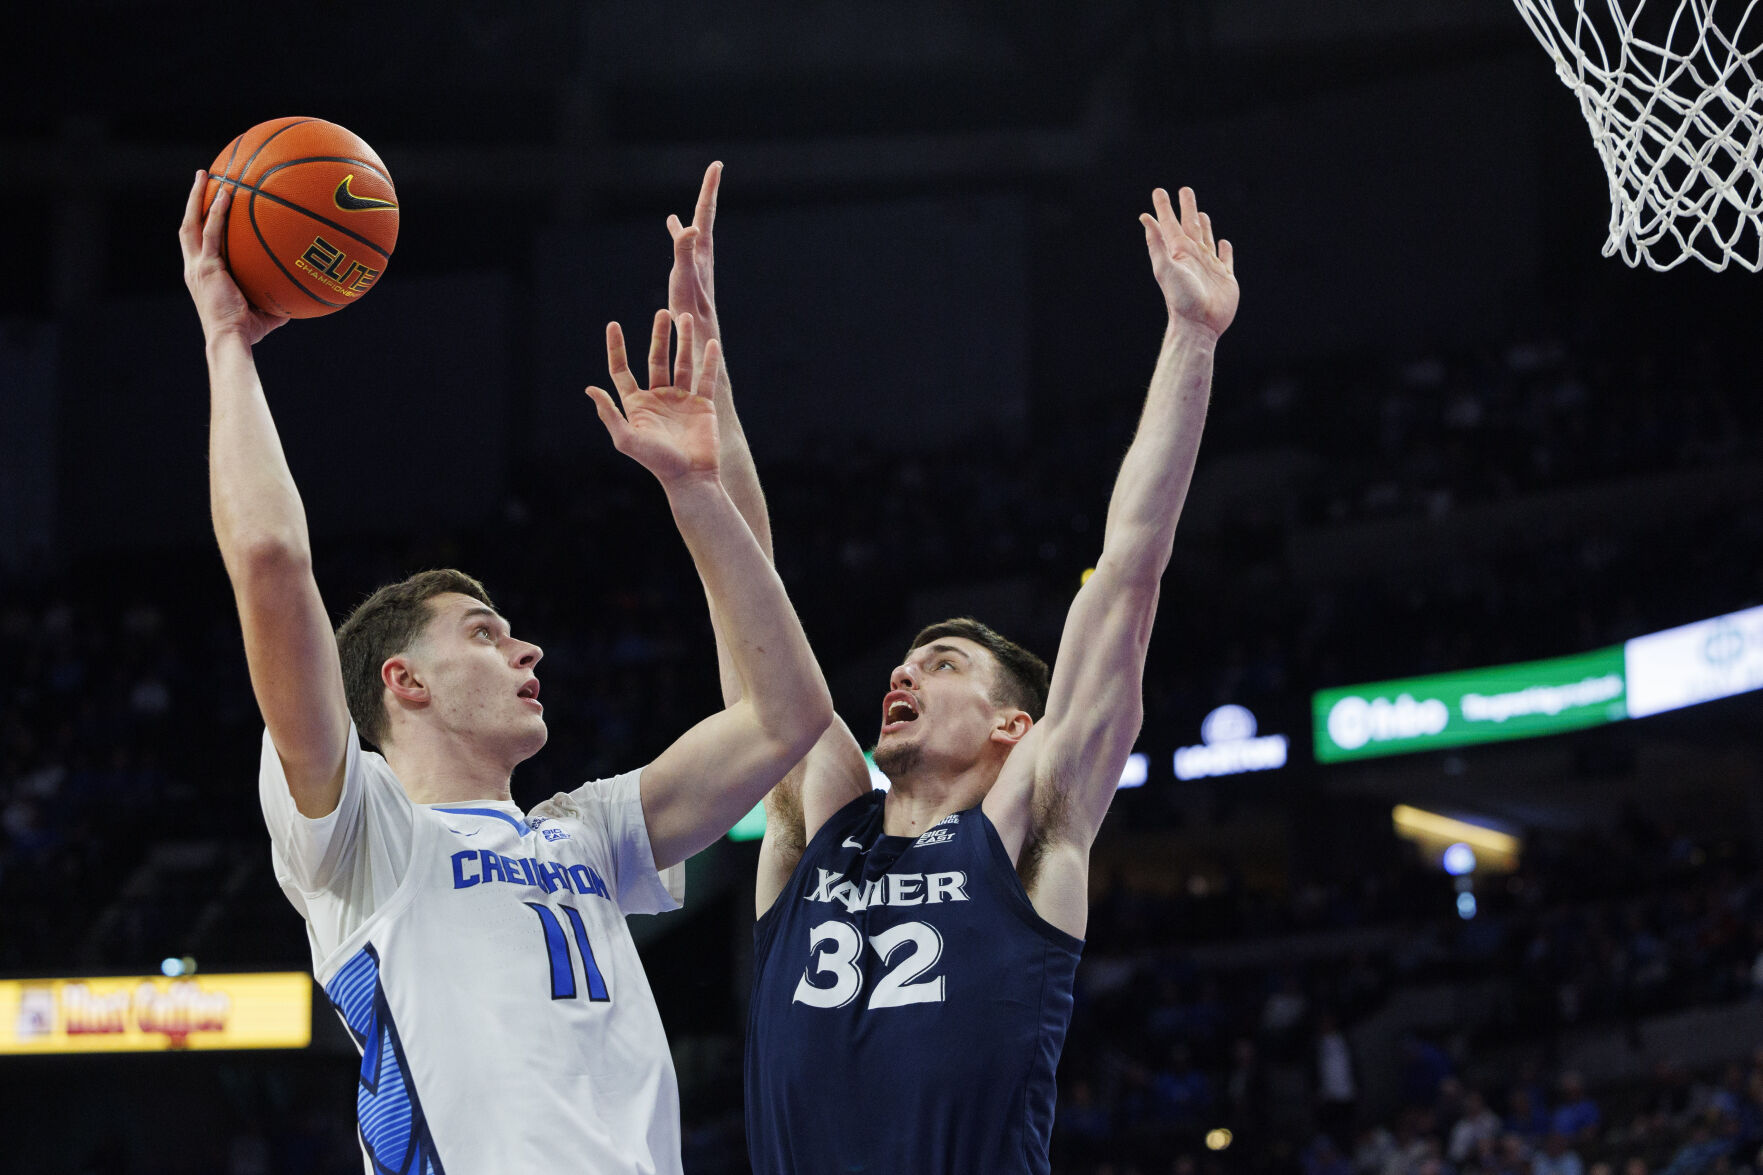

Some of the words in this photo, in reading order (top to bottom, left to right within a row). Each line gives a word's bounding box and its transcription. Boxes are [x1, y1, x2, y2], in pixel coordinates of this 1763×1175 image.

[301, 236, 379, 292] ELITE
[916, 833, 956, 845] EAST
[920, 829, 948, 840] BIG
[803, 867, 970, 914] XAVIER
[523, 902, 611, 1002] 11
[792, 920, 945, 1010] 32
